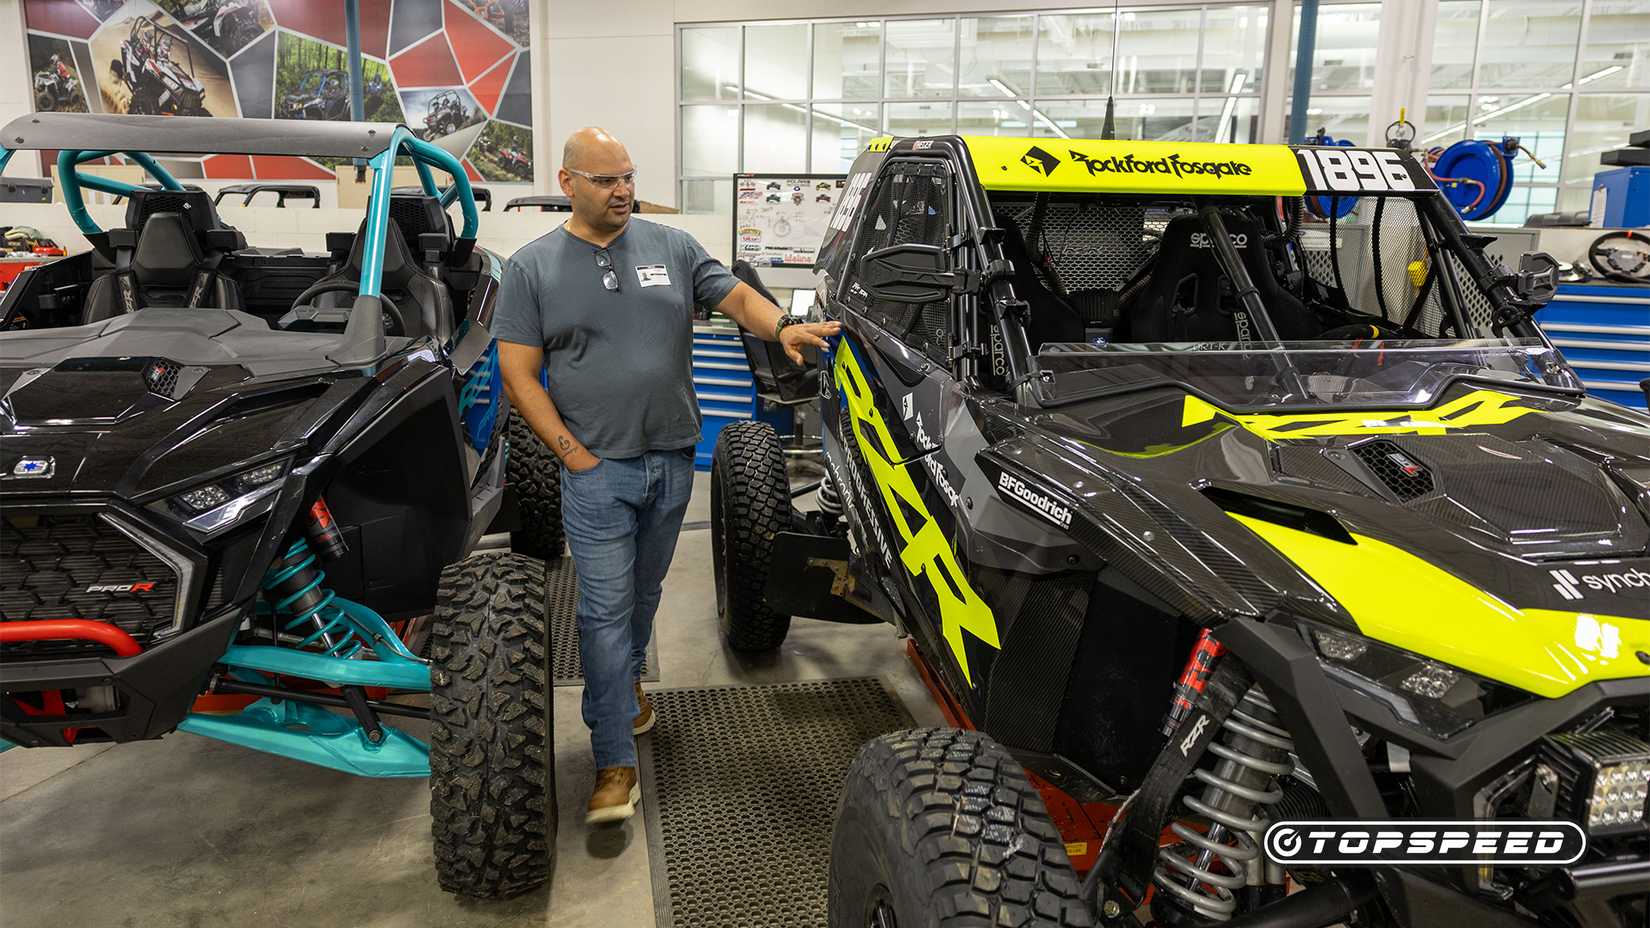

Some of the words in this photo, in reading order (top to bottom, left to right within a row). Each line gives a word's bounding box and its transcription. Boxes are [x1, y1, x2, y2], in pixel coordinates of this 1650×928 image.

[1068, 150, 1172, 177] Rockford
[1167, 153, 1252, 179] Fosgate
[1297, 149, 1416, 191] 1896
[834, 335, 1001, 689] RZR
[999, 471, 1073, 525] BFGoodrich
[1180, 714, 1211, 757] RZR
